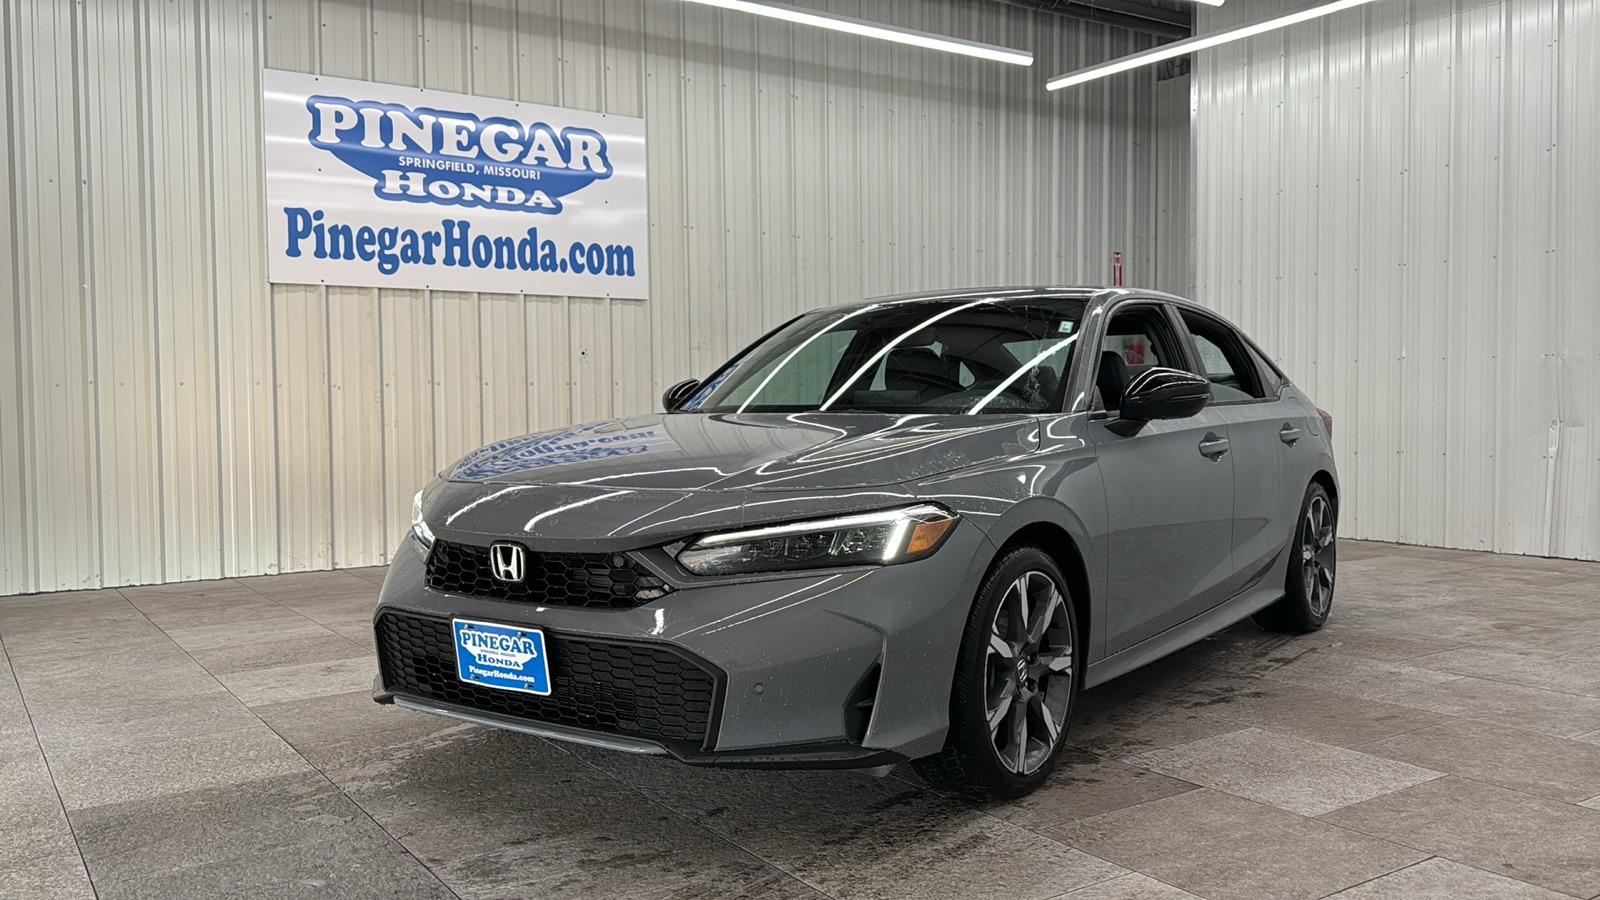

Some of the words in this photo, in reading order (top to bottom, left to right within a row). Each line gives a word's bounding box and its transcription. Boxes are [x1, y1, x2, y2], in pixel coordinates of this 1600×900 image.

[314, 103, 608, 172] PINEGAR
[398, 155, 480, 176] SPRINGFIELD,
[483, 165, 541, 181] MISSOURI
[381, 169, 557, 208] HONDA
[284, 207, 635, 276] PinegarHonda.com
[461, 632, 535, 655] PINEGAR
[477, 653, 521, 668] HONDA
[468, 665, 535, 683] PinegarHonda.com
